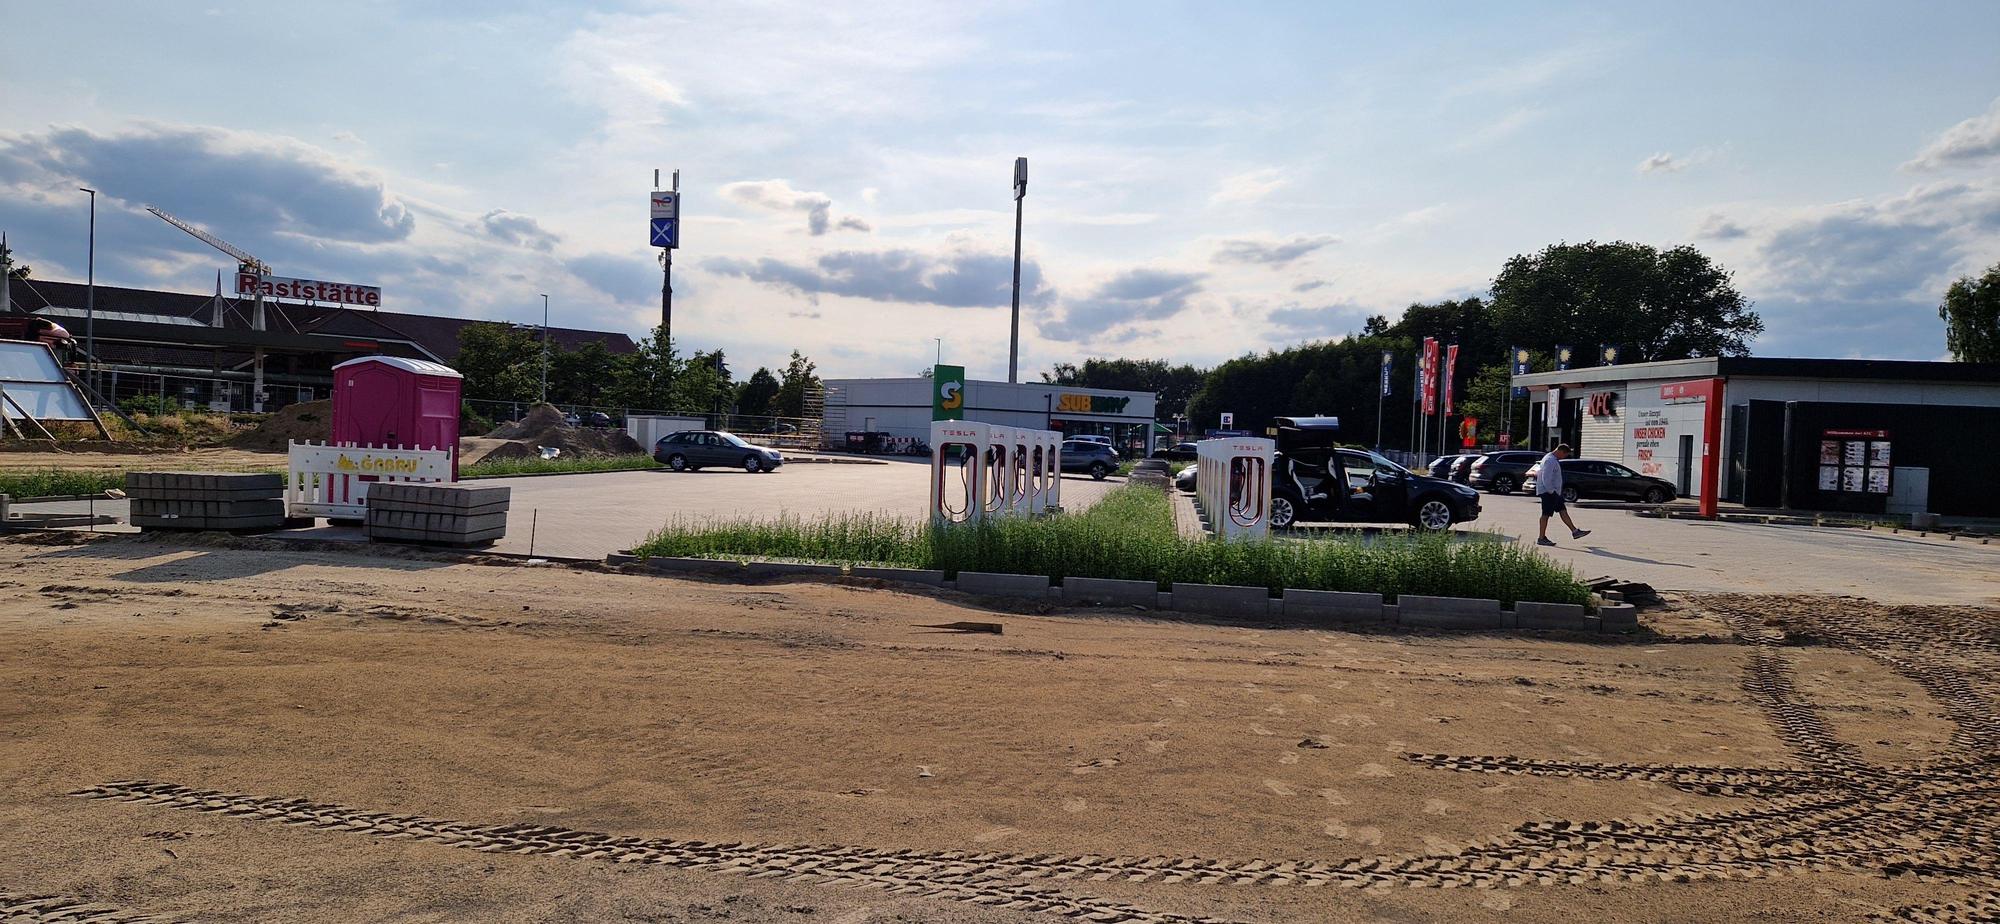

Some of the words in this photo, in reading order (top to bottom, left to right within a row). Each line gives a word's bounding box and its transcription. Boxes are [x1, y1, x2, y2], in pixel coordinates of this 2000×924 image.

[239, 274, 380, 305] Raststätte
[1056, 393, 1131, 414] SUBWAY
[1587, 391, 1612, 417] KFC
[942, 429, 976, 437] TESLA
